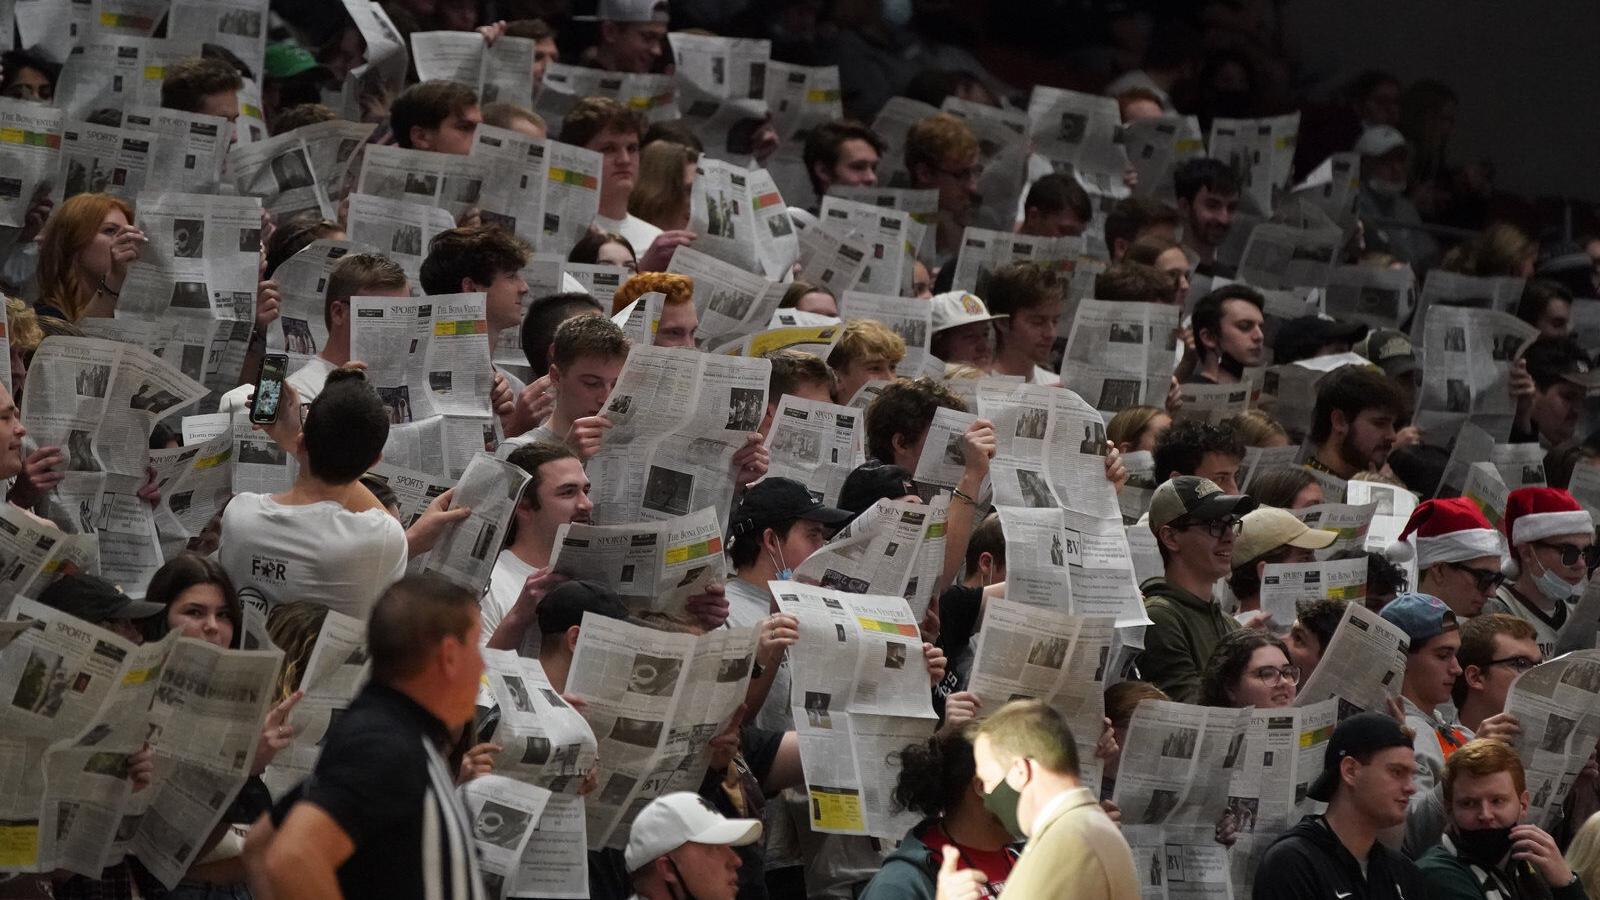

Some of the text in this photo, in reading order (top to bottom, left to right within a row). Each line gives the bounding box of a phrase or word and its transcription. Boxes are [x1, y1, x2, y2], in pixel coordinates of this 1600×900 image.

[87, 130, 118, 143] SPORTS
[391, 305, 417, 314] SPORTS
[396, 475, 424, 489] SPORTS
[597, 535, 630, 545] SPORTS
[668, 533, 678, 543] THE
[1066, 538, 1079, 555] BV
[57, 622, 93, 643] SPORTS
[1375, 624, 1397, 642] SPORTS
